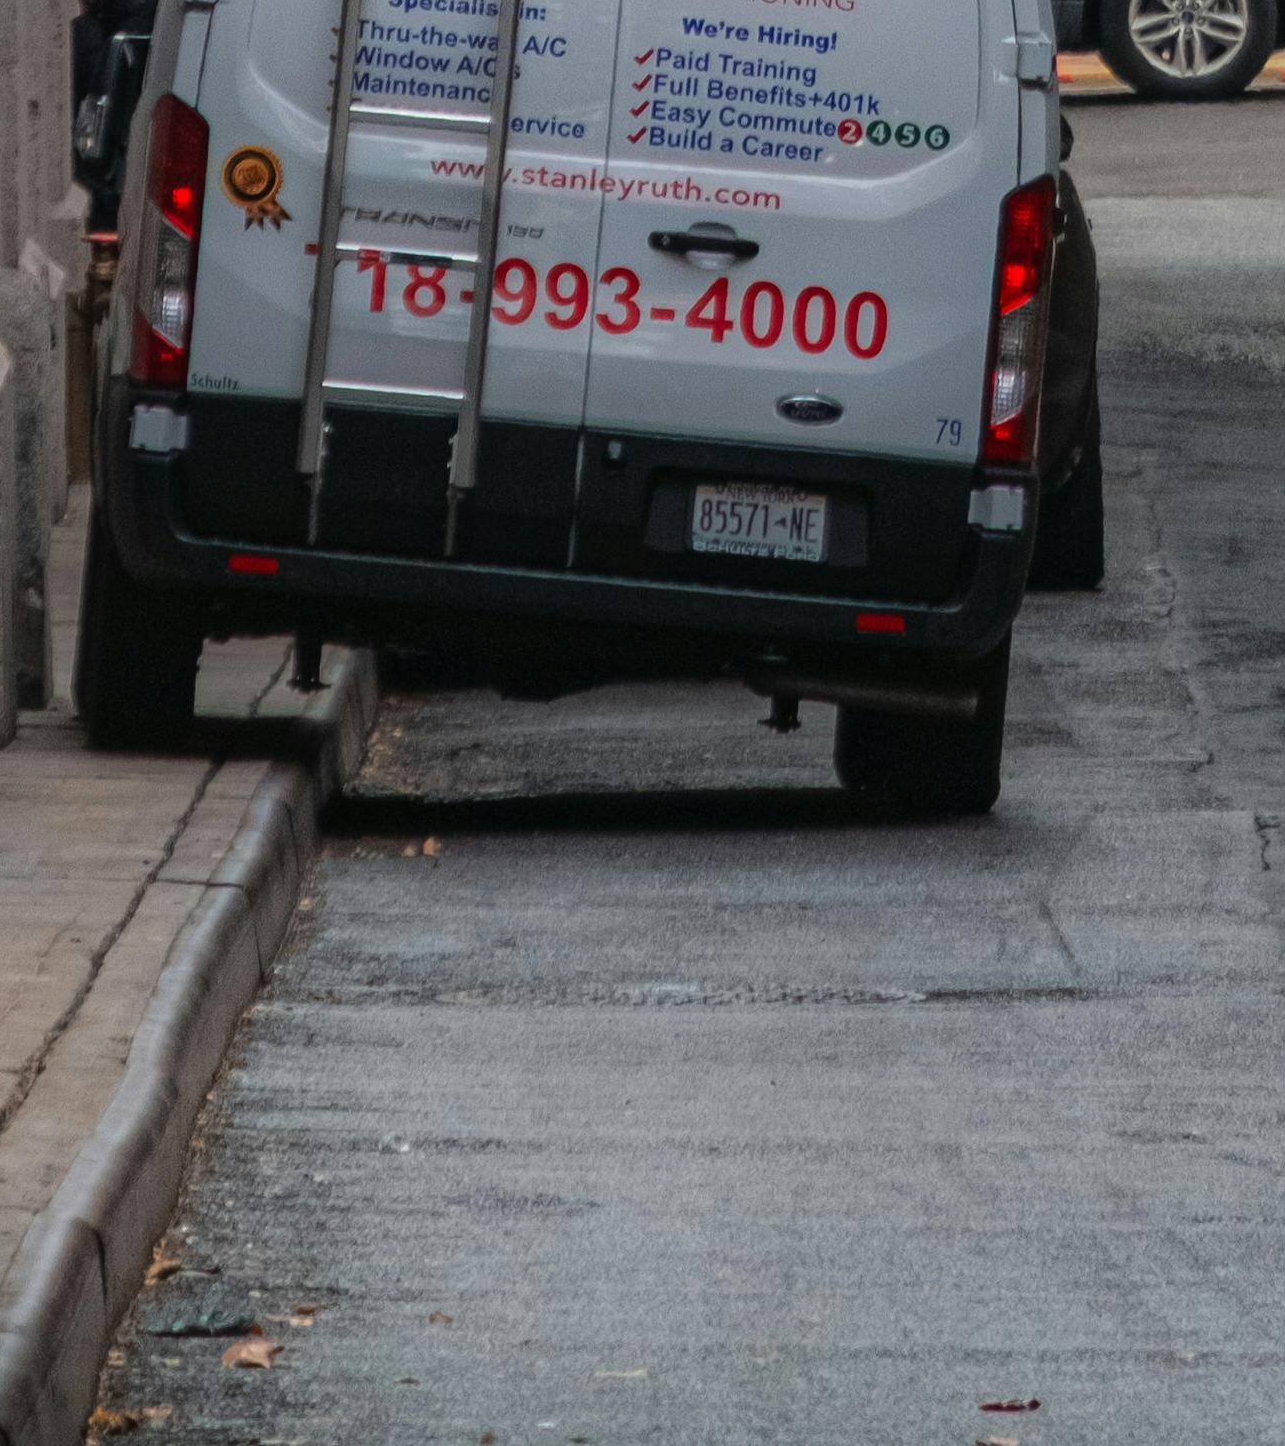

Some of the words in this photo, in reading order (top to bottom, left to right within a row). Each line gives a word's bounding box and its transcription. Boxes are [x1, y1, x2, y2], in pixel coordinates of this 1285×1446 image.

[357, 19, 500, 50] Thru-the-wa
[522, 36, 567, 58] A/C
[681, 16, 750, 43] We're
[757, 24, 838, 54] Hiring!
[355, 46, 451, 73] Window
[655, 47, 710, 73] Paid
[718, 53, 817, 89] Training
[351, 71, 492, 104] Maintenanc
[653, 73, 699, 98] Full
[706, 79, 881, 116] Benefits+401k
[510, 116, 586, 139] ervice
[650, 100, 711, 129] Easy
[718, 106, 837, 138] Commute
[648, 125, 713, 152] Build
[718, 134, 735, 154] a
[741, 134, 825, 163] Career
[189, 373, 240, 392] Schultz
[935, 418, 962, 447] 79
[699, 498, 770, 539] 85571
